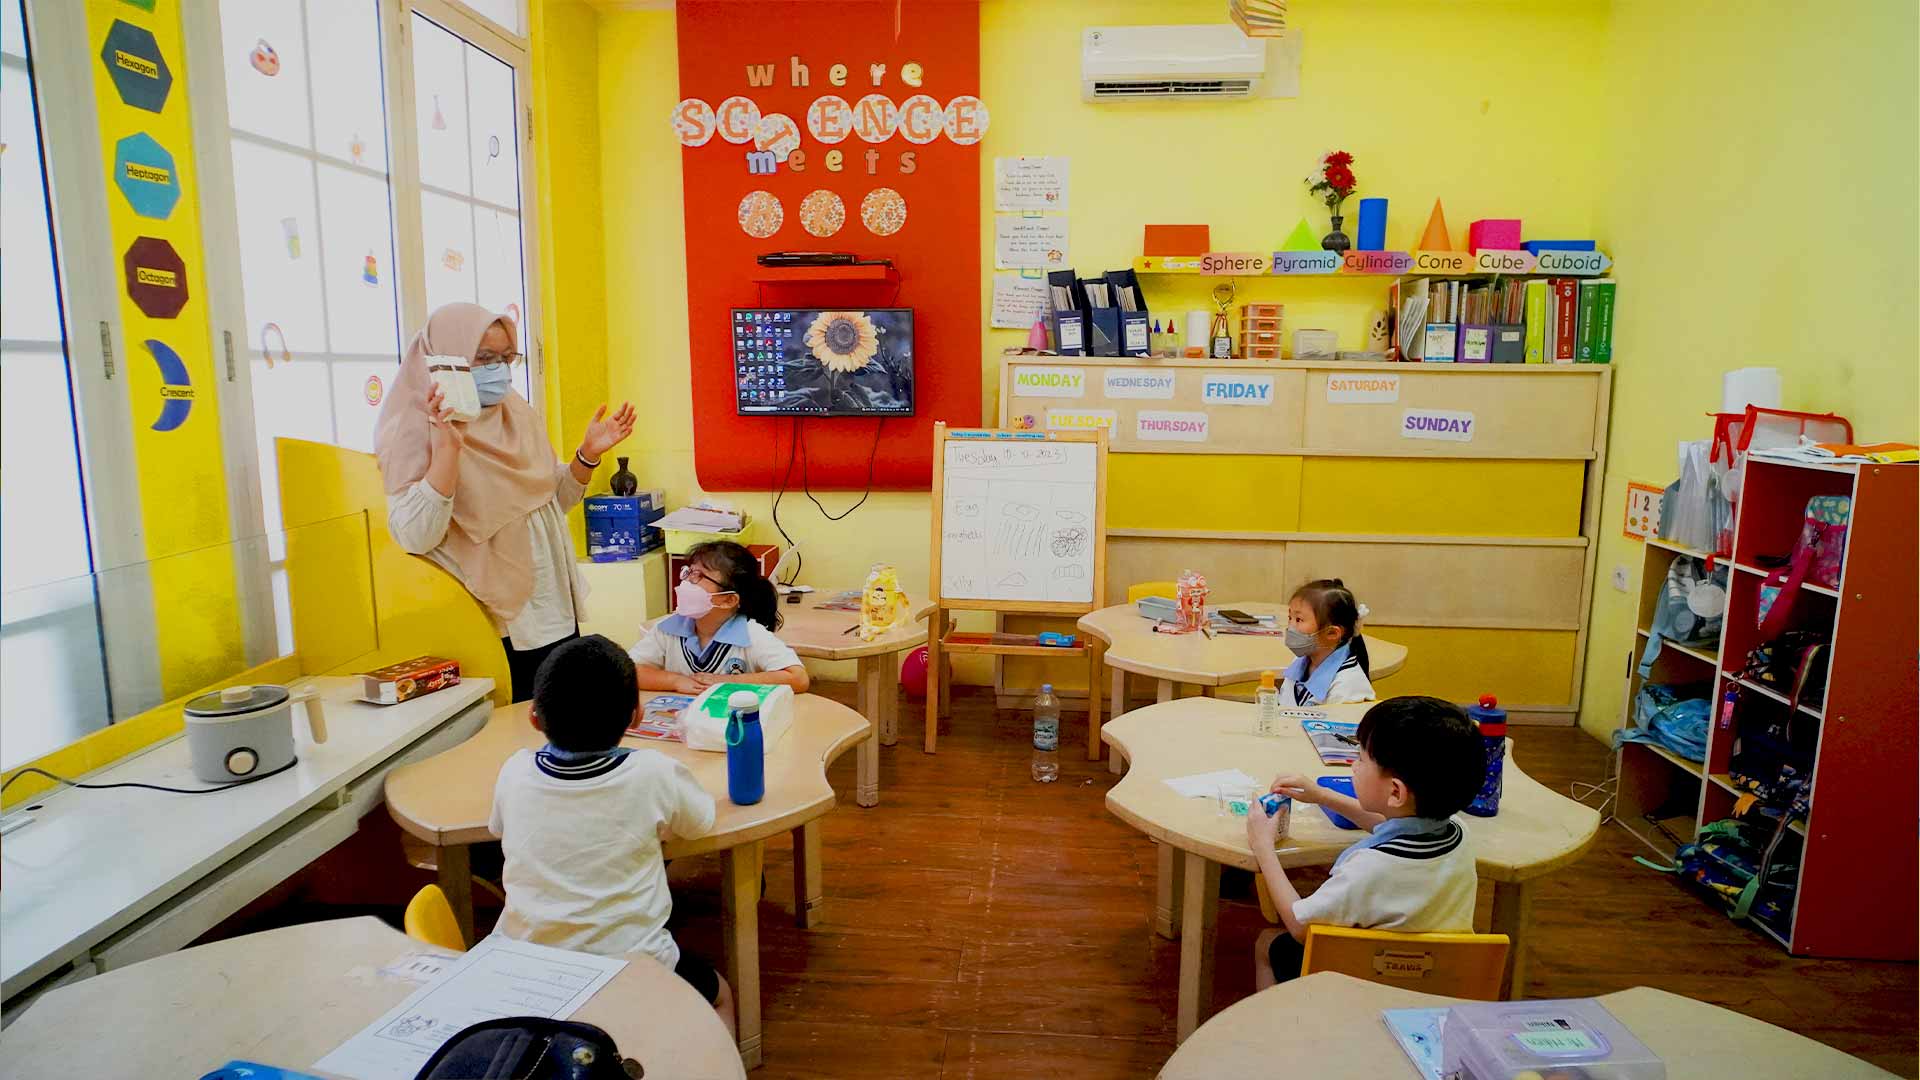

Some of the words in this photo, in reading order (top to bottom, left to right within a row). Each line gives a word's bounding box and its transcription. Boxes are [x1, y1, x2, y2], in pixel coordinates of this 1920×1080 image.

[116, 52, 157, 76] Hexagon
[746, 56, 924, 87] where
[681, 99, 980, 150] SCIENCE
[746, 149, 917, 174] meets
[126, 165, 170, 182] Heptagon
[1202, 256, 1263, 274] Sphere
[1274, 256, 1337, 272] Pyramid
[1345, 254, 1412, 271] Cylinder
[1418, 254, 1463, 269] Cone
[1479, 254, 1525, 269] Cube
[1539, 254, 1602, 270] Cuboid
[139, 270, 176, 285] Octagon
[1017, 373, 1082, 387] MONDAY
[1107, 377, 1172, 388] WEDNESDAY
[1330, 379, 1398, 392] SATURDAY
[160, 386, 195, 398] Crescent
[1206, 382, 1269, 399] FRIDAY
[1050, 415, 1113, 428] TUESDAY
[1139, 419, 1206, 433] THURSDAY
[1405, 416, 1472, 434] SUNDAY
[1643, 495, 1650, 512] 2
